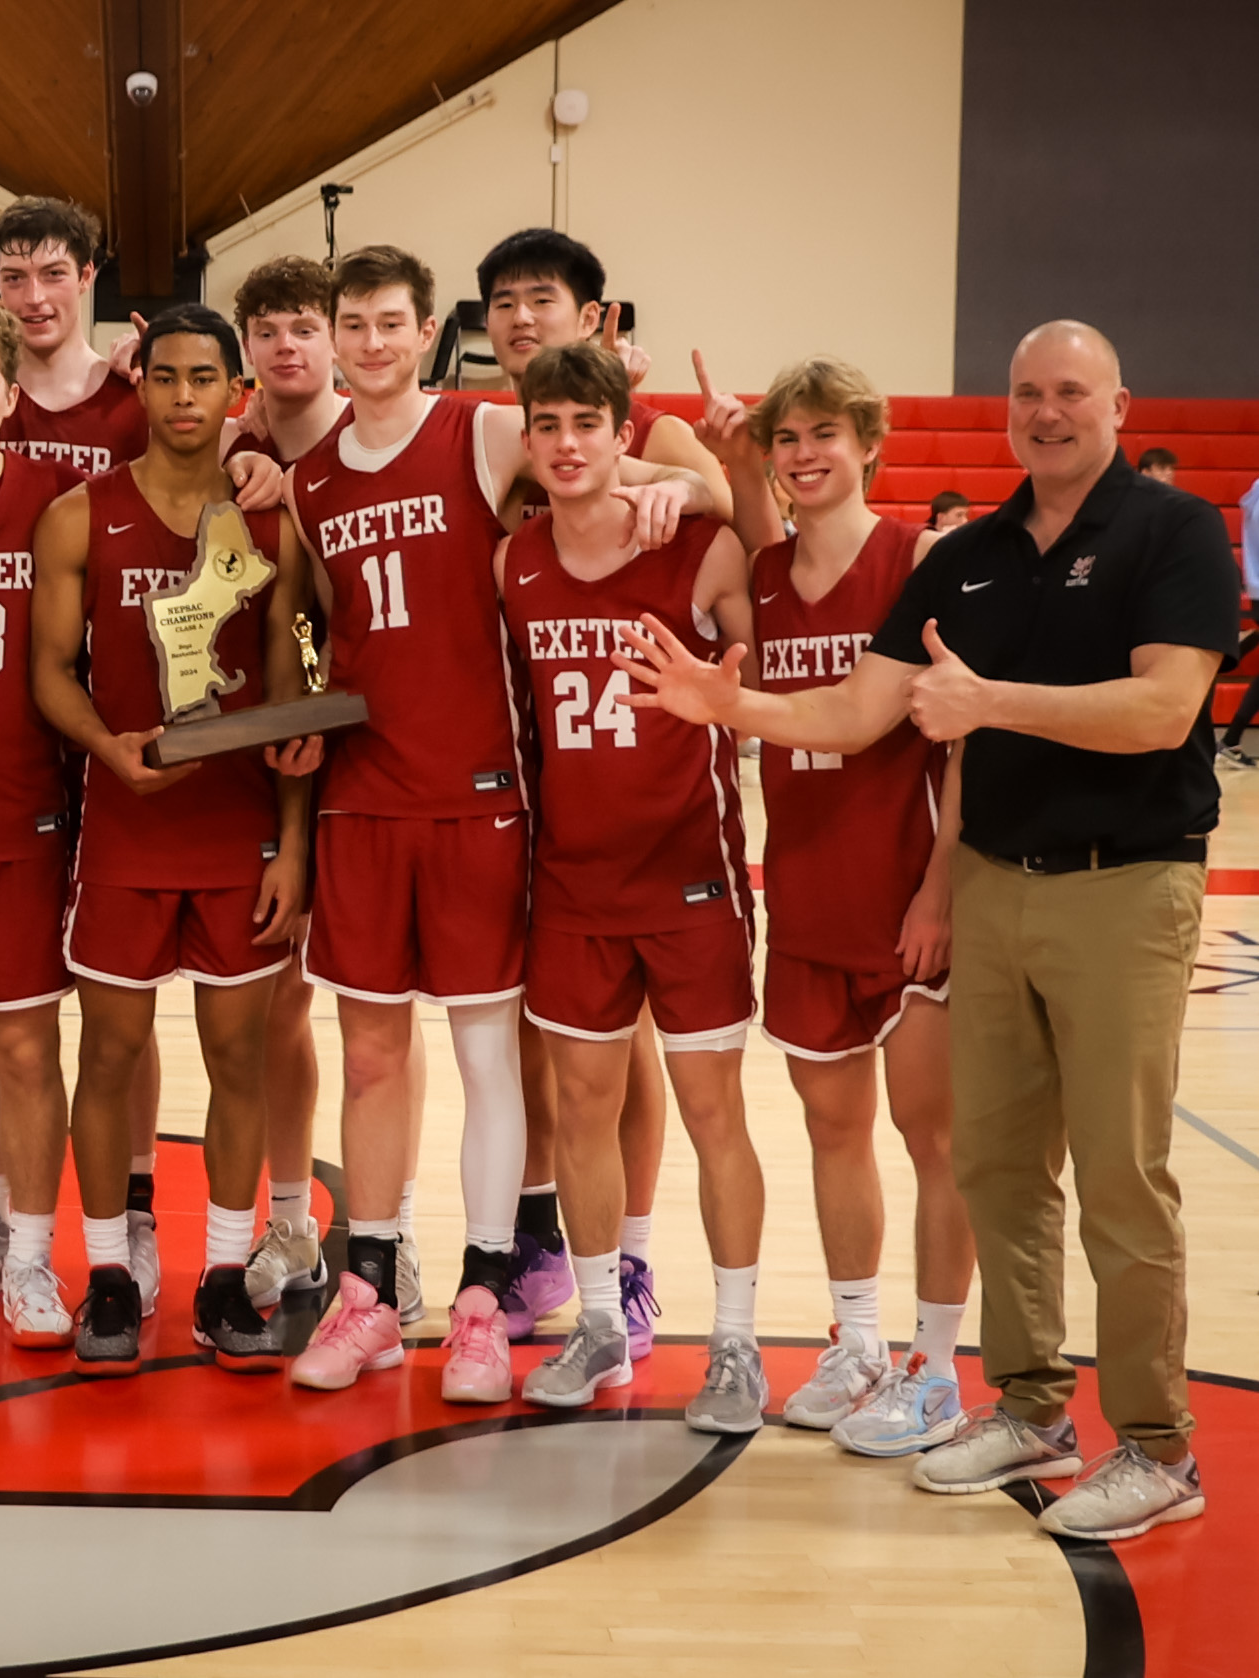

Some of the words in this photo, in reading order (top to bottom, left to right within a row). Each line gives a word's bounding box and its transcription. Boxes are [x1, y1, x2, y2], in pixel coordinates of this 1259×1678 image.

[319, 494, 447, 559] EXETER
[160, 611, 215, 626] CHAMPIONS
[167, 602, 203, 616] NEPSAC
[361, 550, 410, 631] 11
[553, 669, 637, 750] 24
